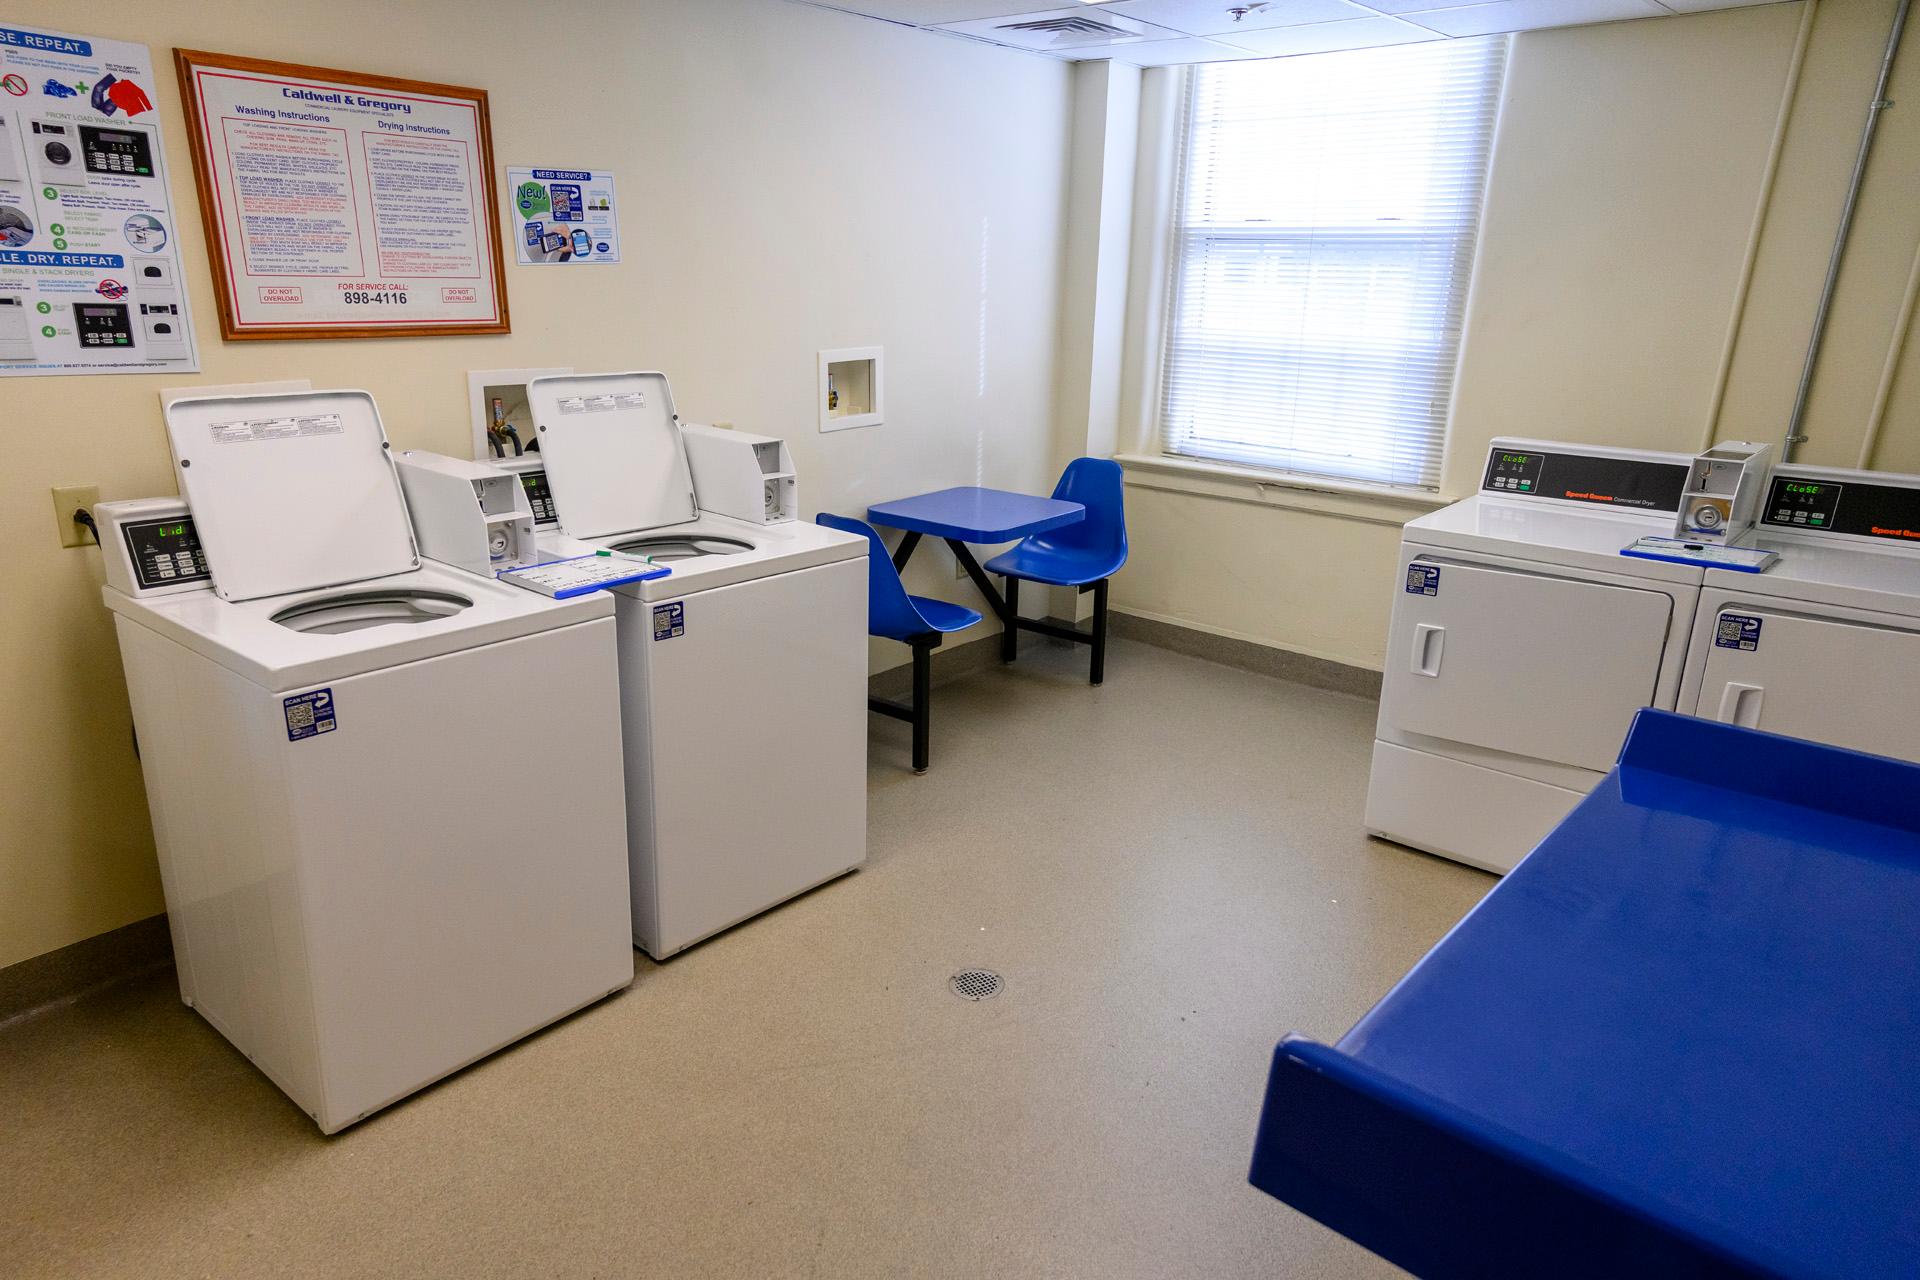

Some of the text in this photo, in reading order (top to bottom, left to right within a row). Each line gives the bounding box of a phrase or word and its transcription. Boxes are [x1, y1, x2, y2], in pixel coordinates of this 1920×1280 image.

[24, 35, 84, 54] REPEAT.
[282, 88, 412, 114] Caldwell & Gregory
[46, 112, 126, 125] FRONT LOAD WASHER
[235, 105, 330, 123] Washing Instructions
[378, 120, 450, 135] Drying Instructions
[556, 172, 588, 180] SERVICE?
[517, 185, 546, 199] New!
[0, 253, 117, 266] LE. DRY. REPEAT.
[344, 292, 407, 304] 898-4116
[1872, 527, 1902, 535] Speed
